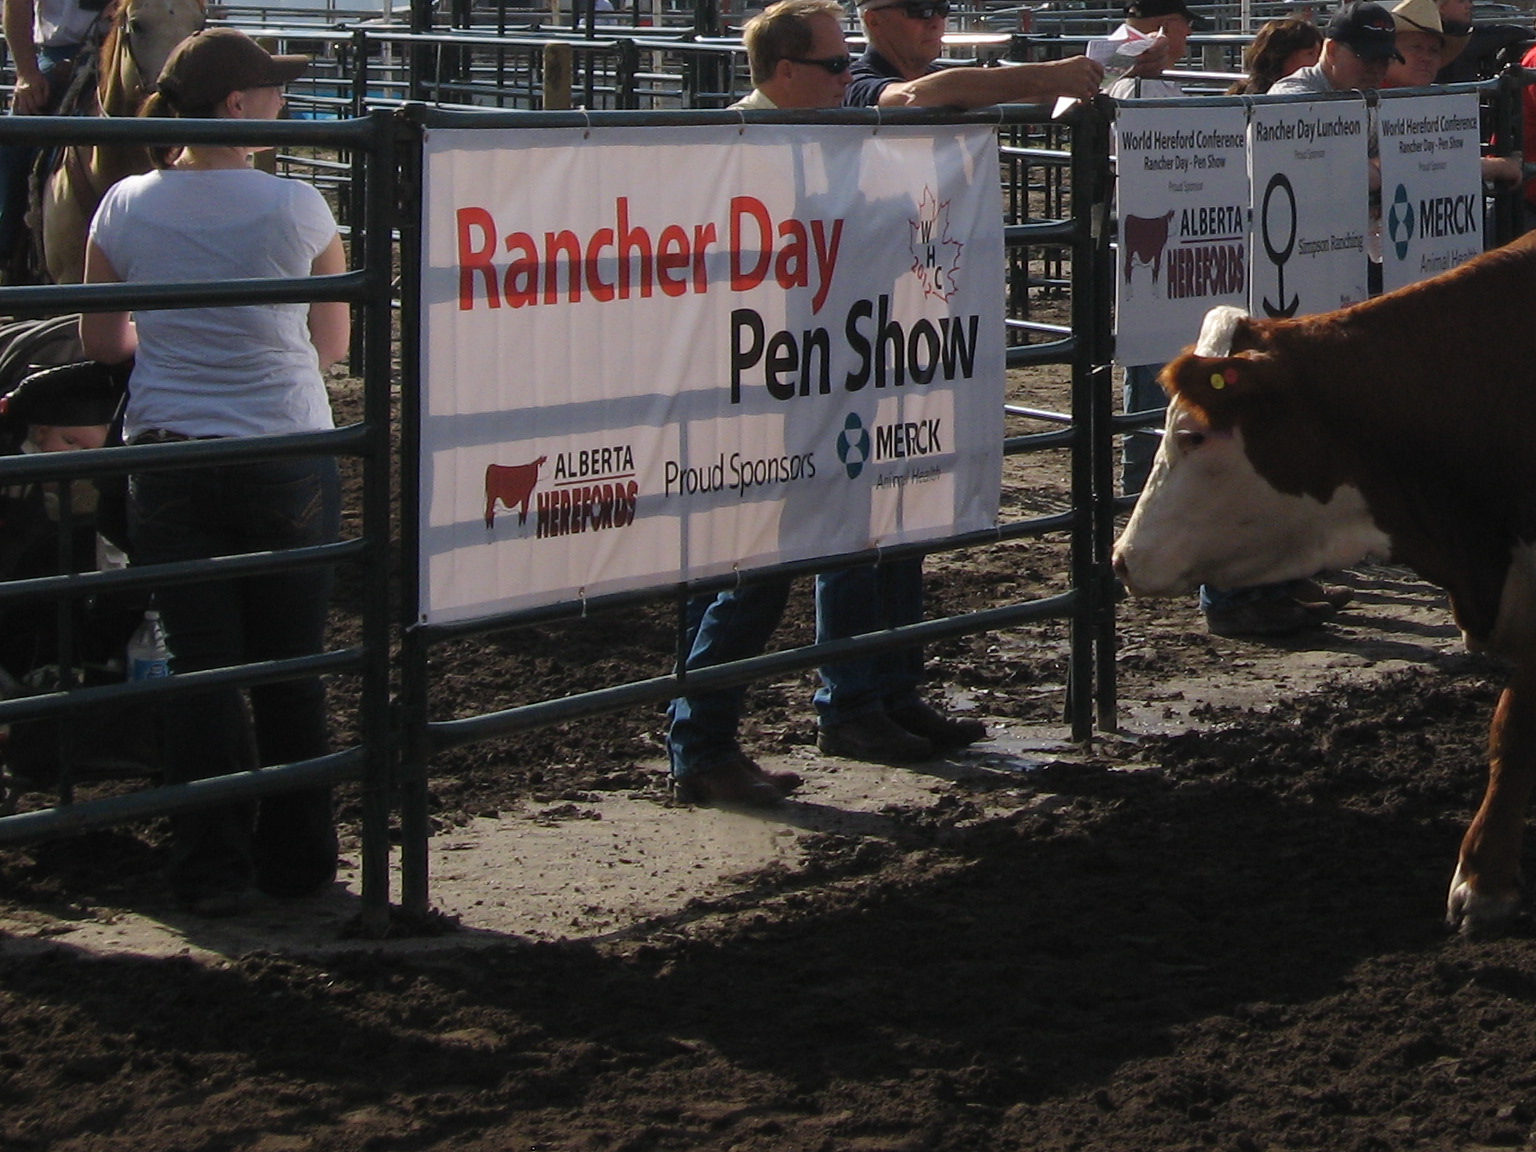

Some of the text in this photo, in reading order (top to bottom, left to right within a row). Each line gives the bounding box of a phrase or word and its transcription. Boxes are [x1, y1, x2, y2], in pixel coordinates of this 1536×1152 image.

[1122, 129, 1244, 150] World Hereford Conference
[1257, 116, 1361, 143] Rancher Day Luncheon
[1382, 114, 1478, 136] World Hereford Conference
[1399, 140, 1422, 153] Rancher
[1423, 138, 1435, 154] Day
[1438, 137, 1448, 150] Pen
[1449, 136, 1464, 149] Show
[1144, 155, 1173, 170] Rancher
[1175, 155, 1189, 173] Day
[1193, 155, 1206, 169] Pen
[1207, 153, 1226, 168] Show
[1180, 206, 1243, 236] ALBERTA
[1420, 194, 1477, 239] MERCK
[456, 195, 844, 314] Rancher Day
[1421, 250, 1449, 273] Animal
[1167, 243, 1245, 299] HEREFORDS
[730, 294, 980, 404] Pen Show
[876, 418, 941, 460] MERCK
[555, 445, 634, 479] ALBERTA
[665, 451, 816, 497] Proud Sponsors
[911, 465, 941, 485] Health
[537, 479, 638, 539] HEREFORDS
